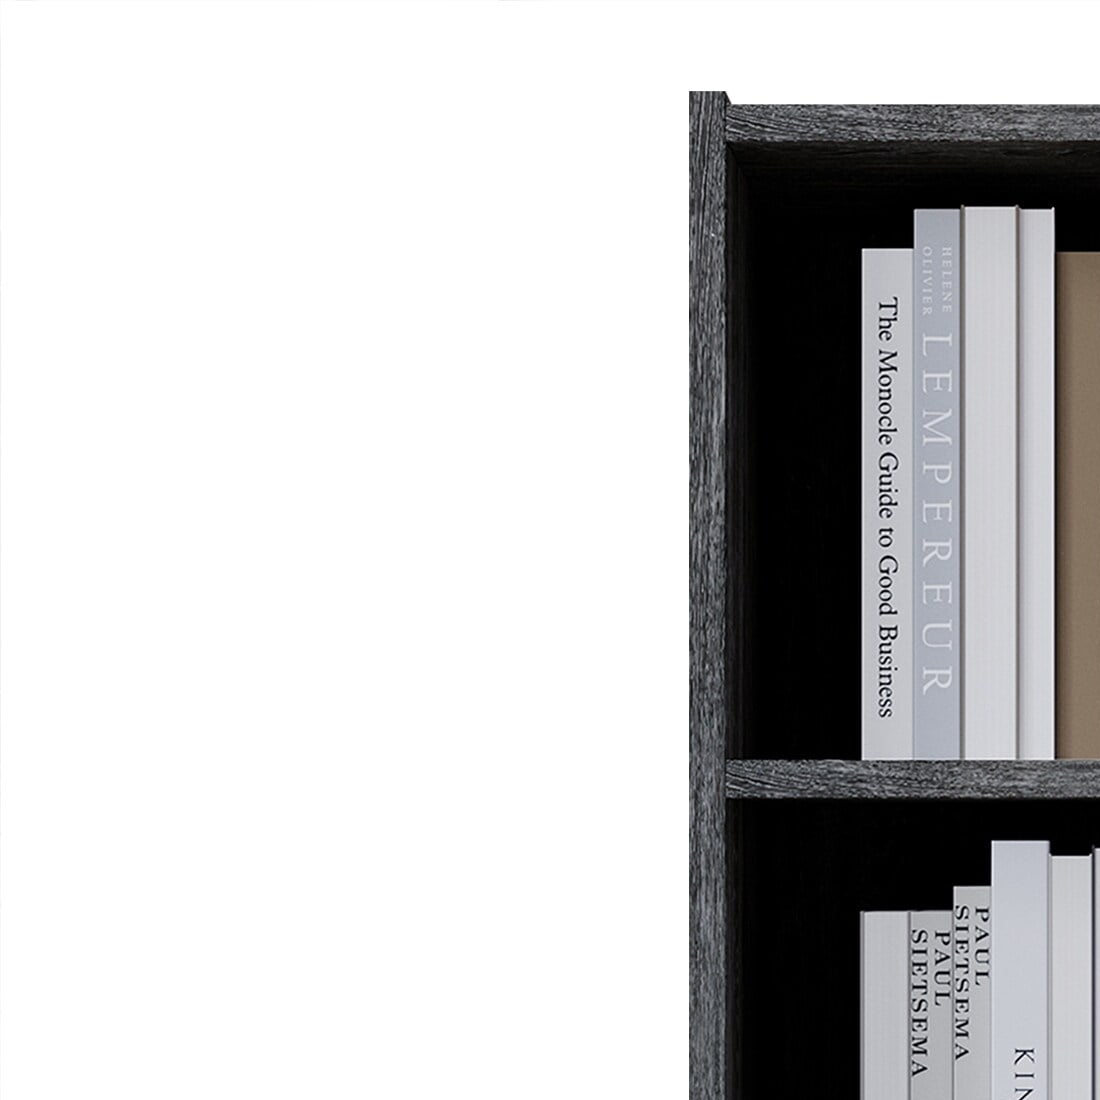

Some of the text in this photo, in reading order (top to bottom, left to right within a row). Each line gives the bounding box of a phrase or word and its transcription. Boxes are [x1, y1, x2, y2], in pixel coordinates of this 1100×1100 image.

[923, 247, 932, 315] OLIVIER
[942, 247, 952, 312] HELENE
[878, 297, 898, 717] The Monocle Guide to Good Business
[923, 334, 952, 695] LEMPEREUR
[935, 932, 950, 1005] PAUL
[955, 905, 970, 1061] SIETSEMA
[975, 908, 989, 985] PAUL
[911, 929, 928, 1078] SIETSEMA
